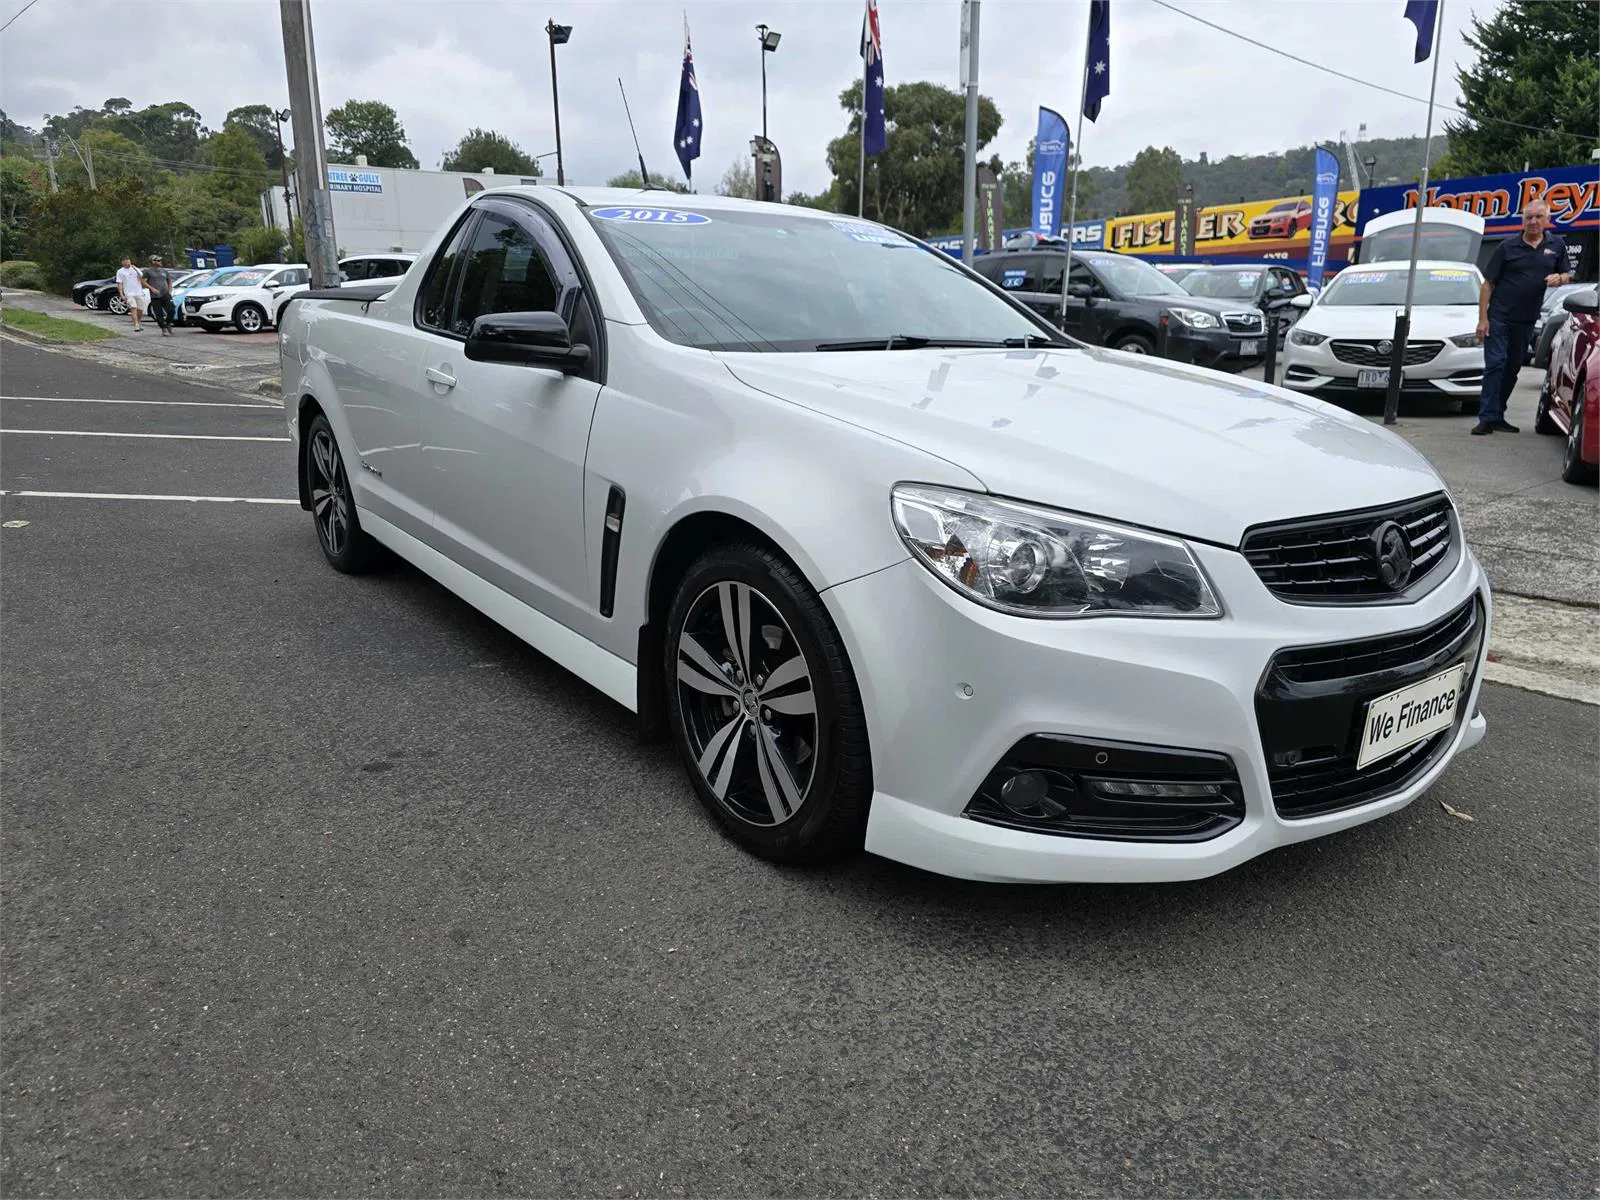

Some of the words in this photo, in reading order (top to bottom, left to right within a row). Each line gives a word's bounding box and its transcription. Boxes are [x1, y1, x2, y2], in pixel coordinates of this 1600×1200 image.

[358, 173, 379, 183] GULLY
[329, 184, 353, 192] RINARY
[1403, 186, 1511, 219] Norm
[613, 209, 688, 222] 2015
[1368, 711, 1394, 746] We
[1396, 688, 1456, 734] Finance
